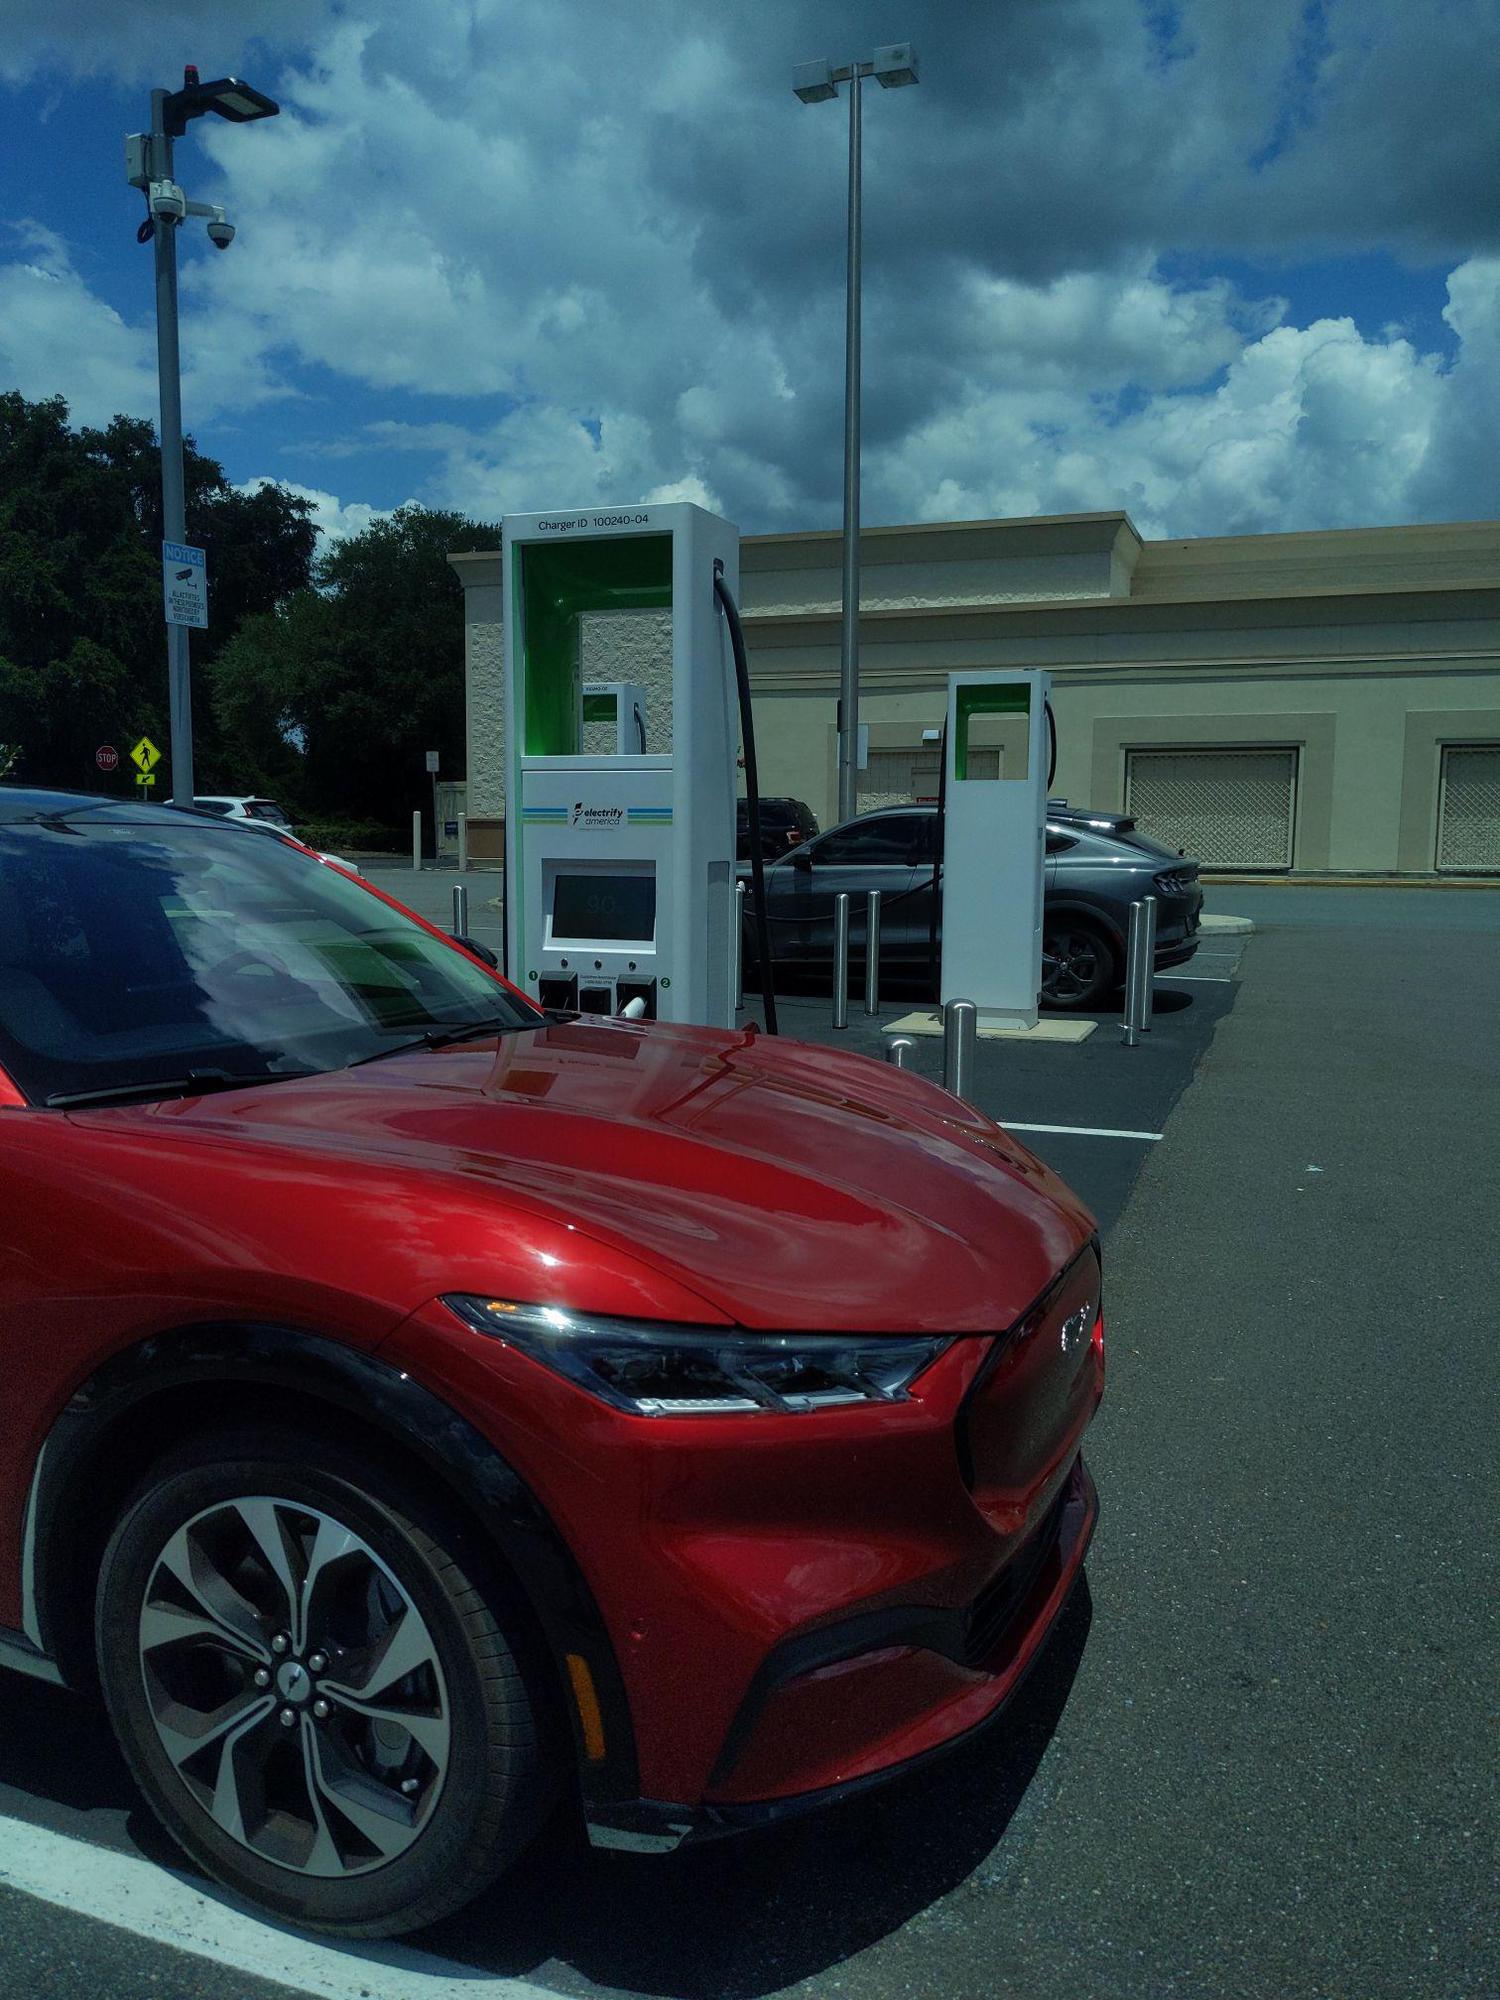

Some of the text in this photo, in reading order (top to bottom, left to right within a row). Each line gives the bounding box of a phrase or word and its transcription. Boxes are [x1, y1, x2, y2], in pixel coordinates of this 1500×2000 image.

[538, 514, 649, 531] Charger ID 100240-04
[166, 544, 204, 566] NOTICE
[98, 753, 116, 763] STOP
[584, 808, 623, 818] electrify
